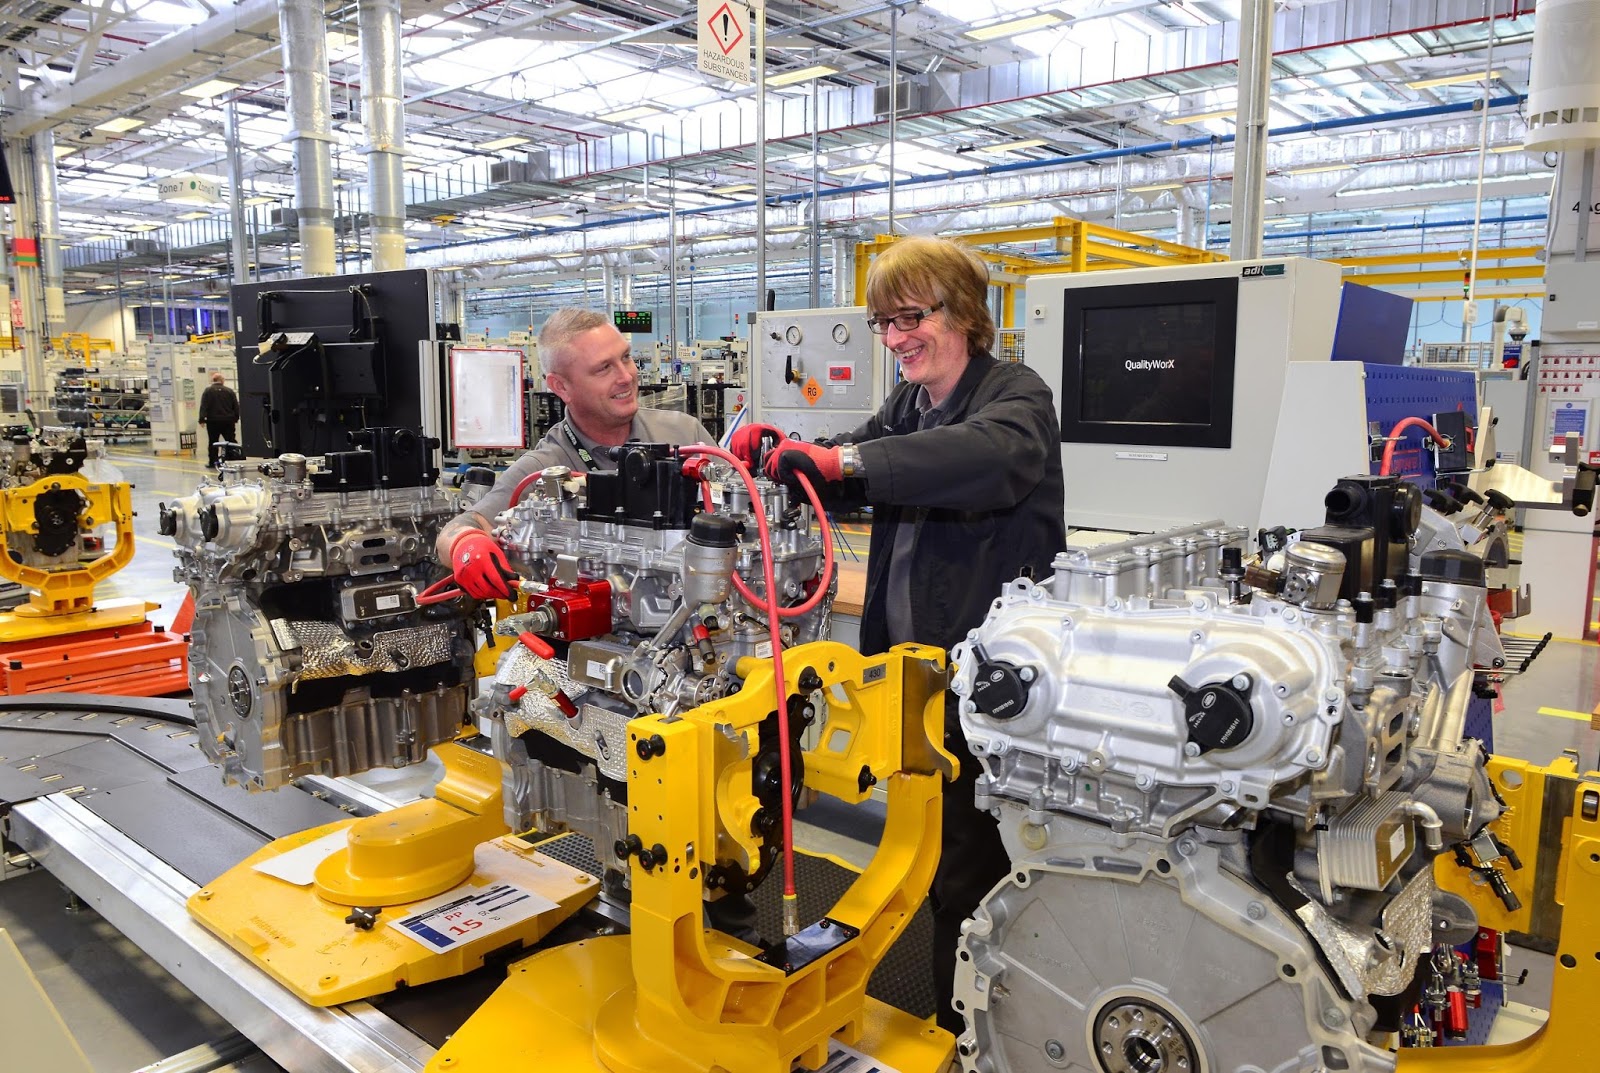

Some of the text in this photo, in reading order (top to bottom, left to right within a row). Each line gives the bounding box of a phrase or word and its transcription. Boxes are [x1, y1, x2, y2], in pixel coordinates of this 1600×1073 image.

[703, 49, 745, 70] HAZARDOUS
[703, 60, 748, 82] SUBSTANCES
[158, 181, 184, 194] Zone 7
[198, 180, 211, 195] Zone
[1243, 266, 1261, 275] adi
[1125, 359, 1175, 371] QualityWorX
[807, 387, 817, 396] RG
[869, 667, 881, 678] 430
[444, 911, 463, 921] PP
[449, 918, 483, 936] 15
